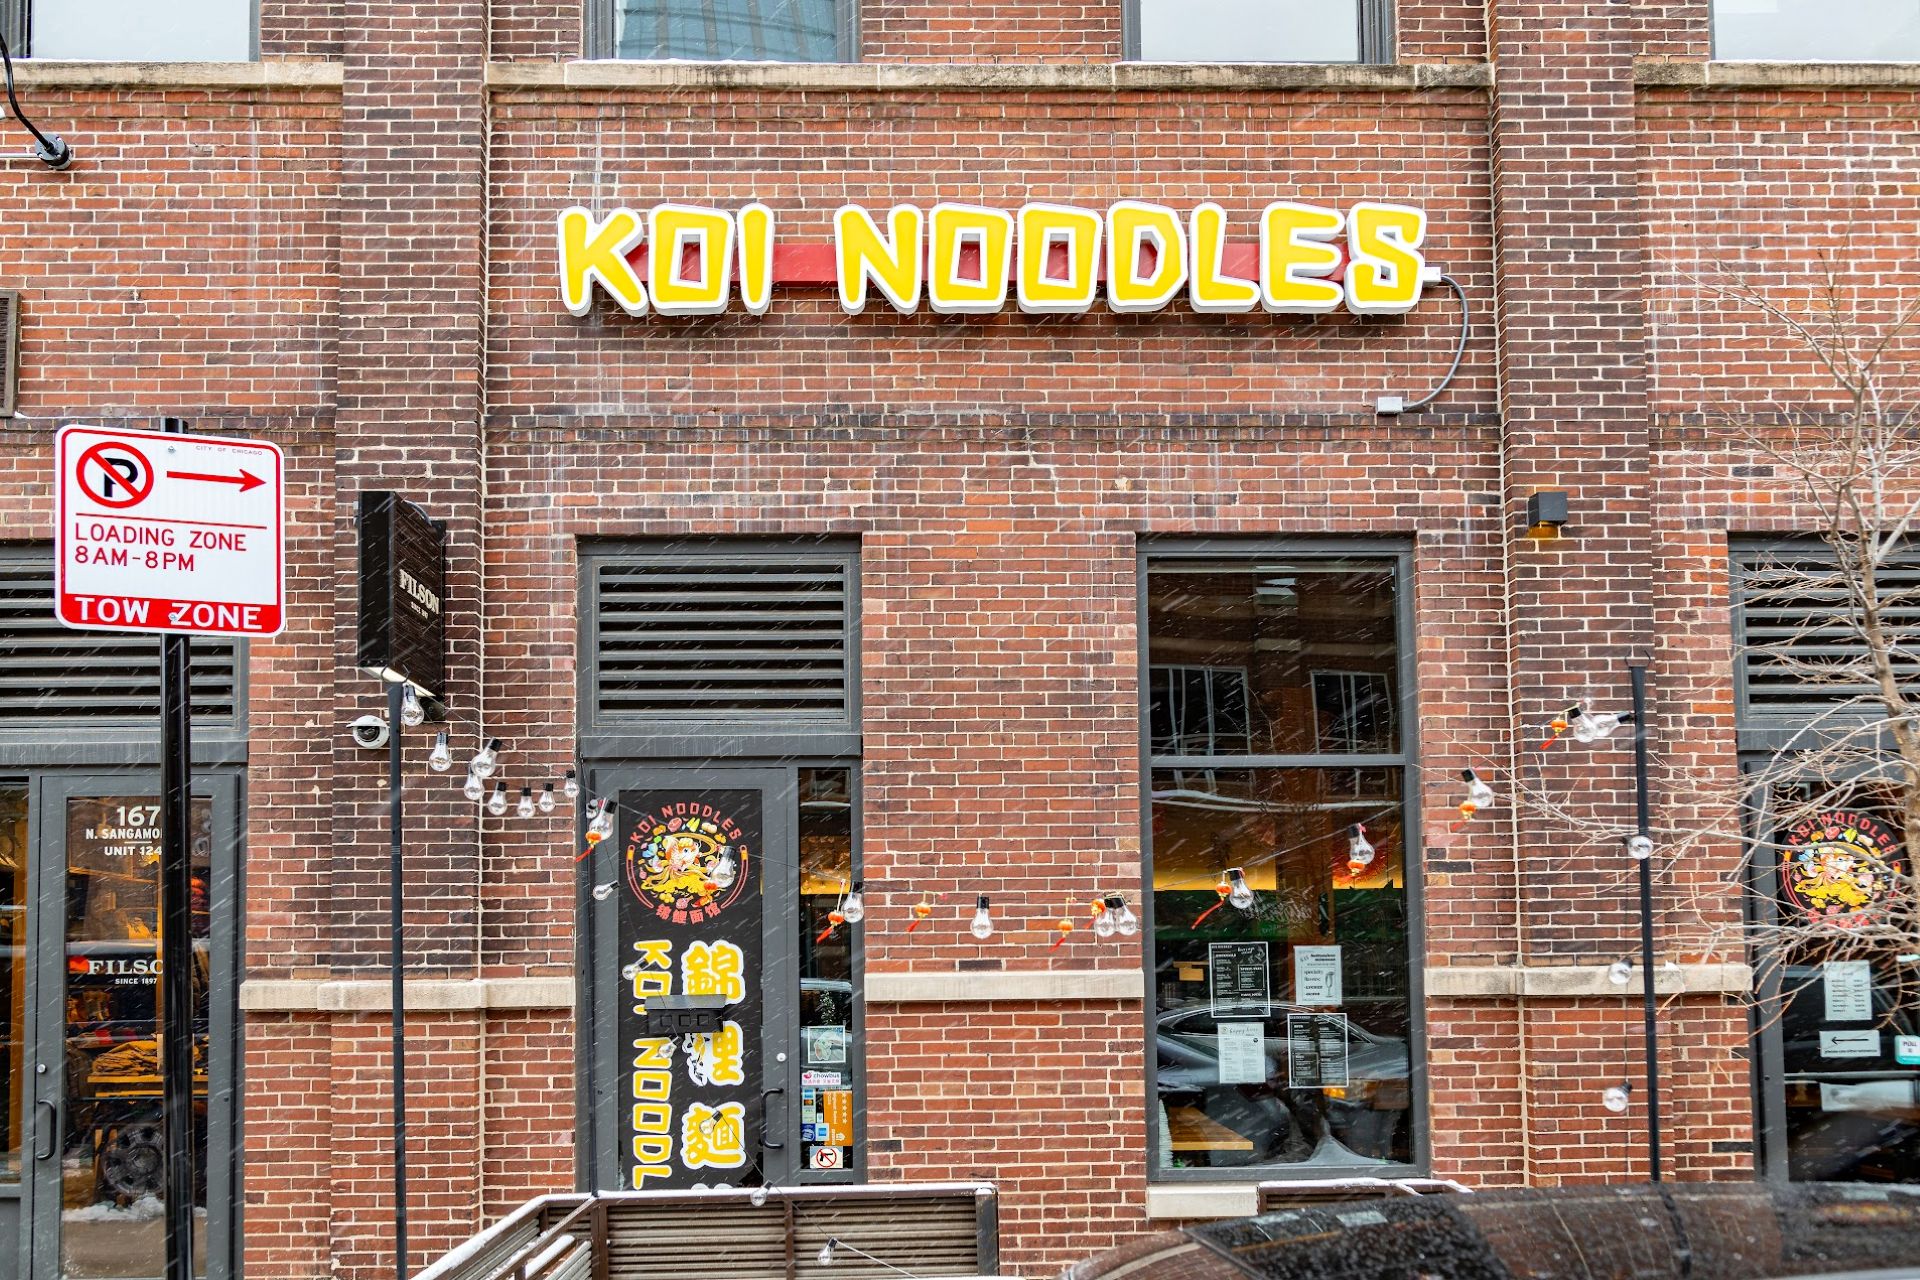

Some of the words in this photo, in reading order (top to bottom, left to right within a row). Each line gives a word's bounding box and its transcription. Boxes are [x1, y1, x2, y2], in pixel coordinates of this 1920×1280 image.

[558, 202, 775, 316] KOI
[833, 201, 1427, 315] NOODLES
[231, 448, 263, 456] CHICAGO
[75, 522, 175, 547] LOADING
[189, 530, 247, 552] ZONE
[399, 568, 440, 615] FILSON
[74, 596, 150, 624] TOW
[169, 602, 262, 630] ZONE
[116, 805, 161, 827] 167
[630, 814, 657, 843] KOI
[661, 802, 742, 840] NOODLES
[85, 828, 98, 840] N.
[102, 828, 162, 840] SANGAMO
[104, 846, 136, 856] UNIT
